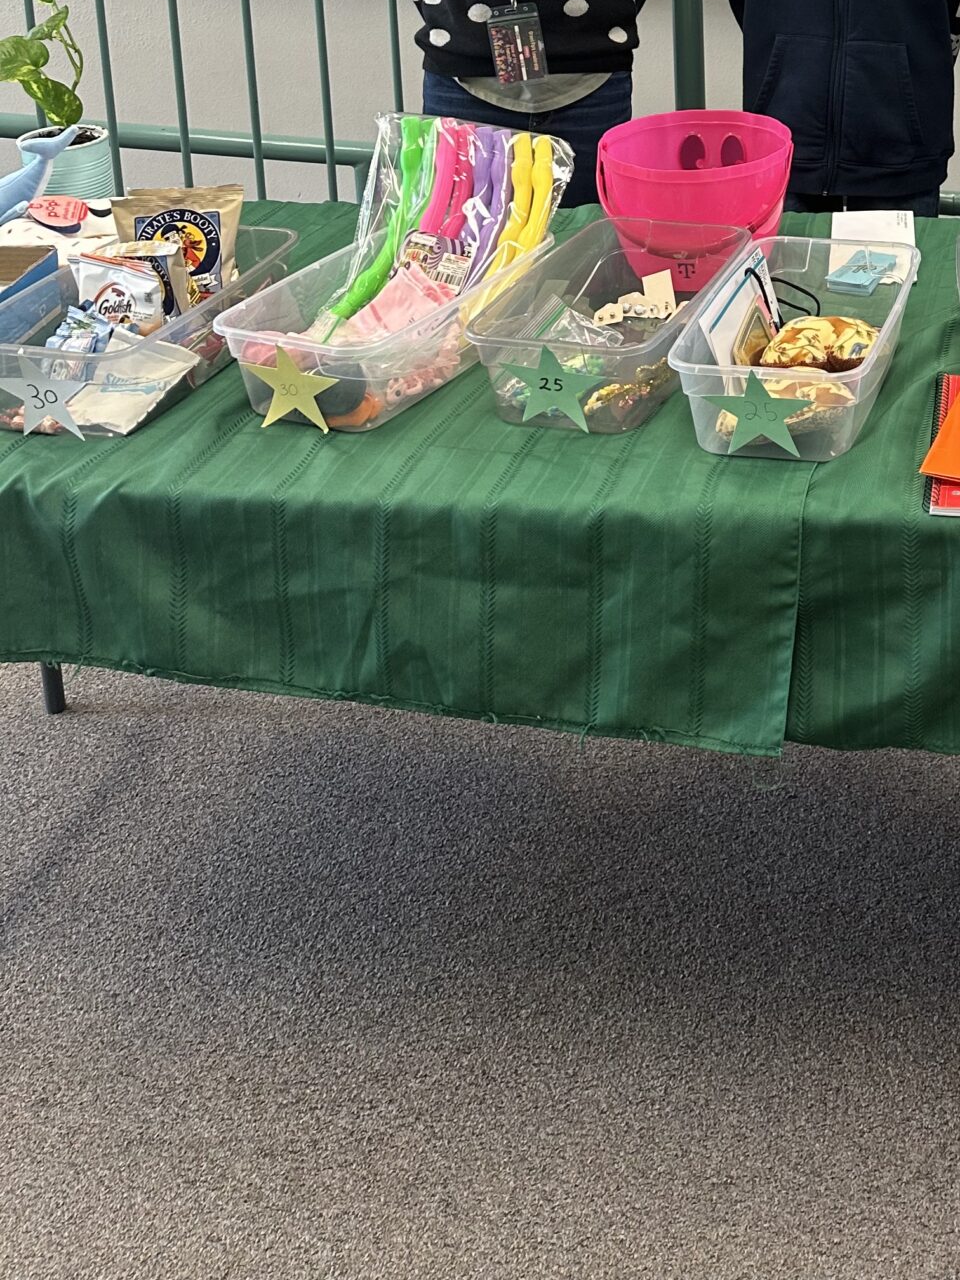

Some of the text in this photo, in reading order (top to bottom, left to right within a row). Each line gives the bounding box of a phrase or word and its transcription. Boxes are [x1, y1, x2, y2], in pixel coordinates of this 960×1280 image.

[140, 210, 218, 241] PIRATE'S BOOTY
[98, 298, 133, 316] Goldfish
[279, 383, 298, 396] 30
[538, 377, 564, 392] 25
[26, 383, 58, 410] 30
[743, 400, 779, 422] 25
